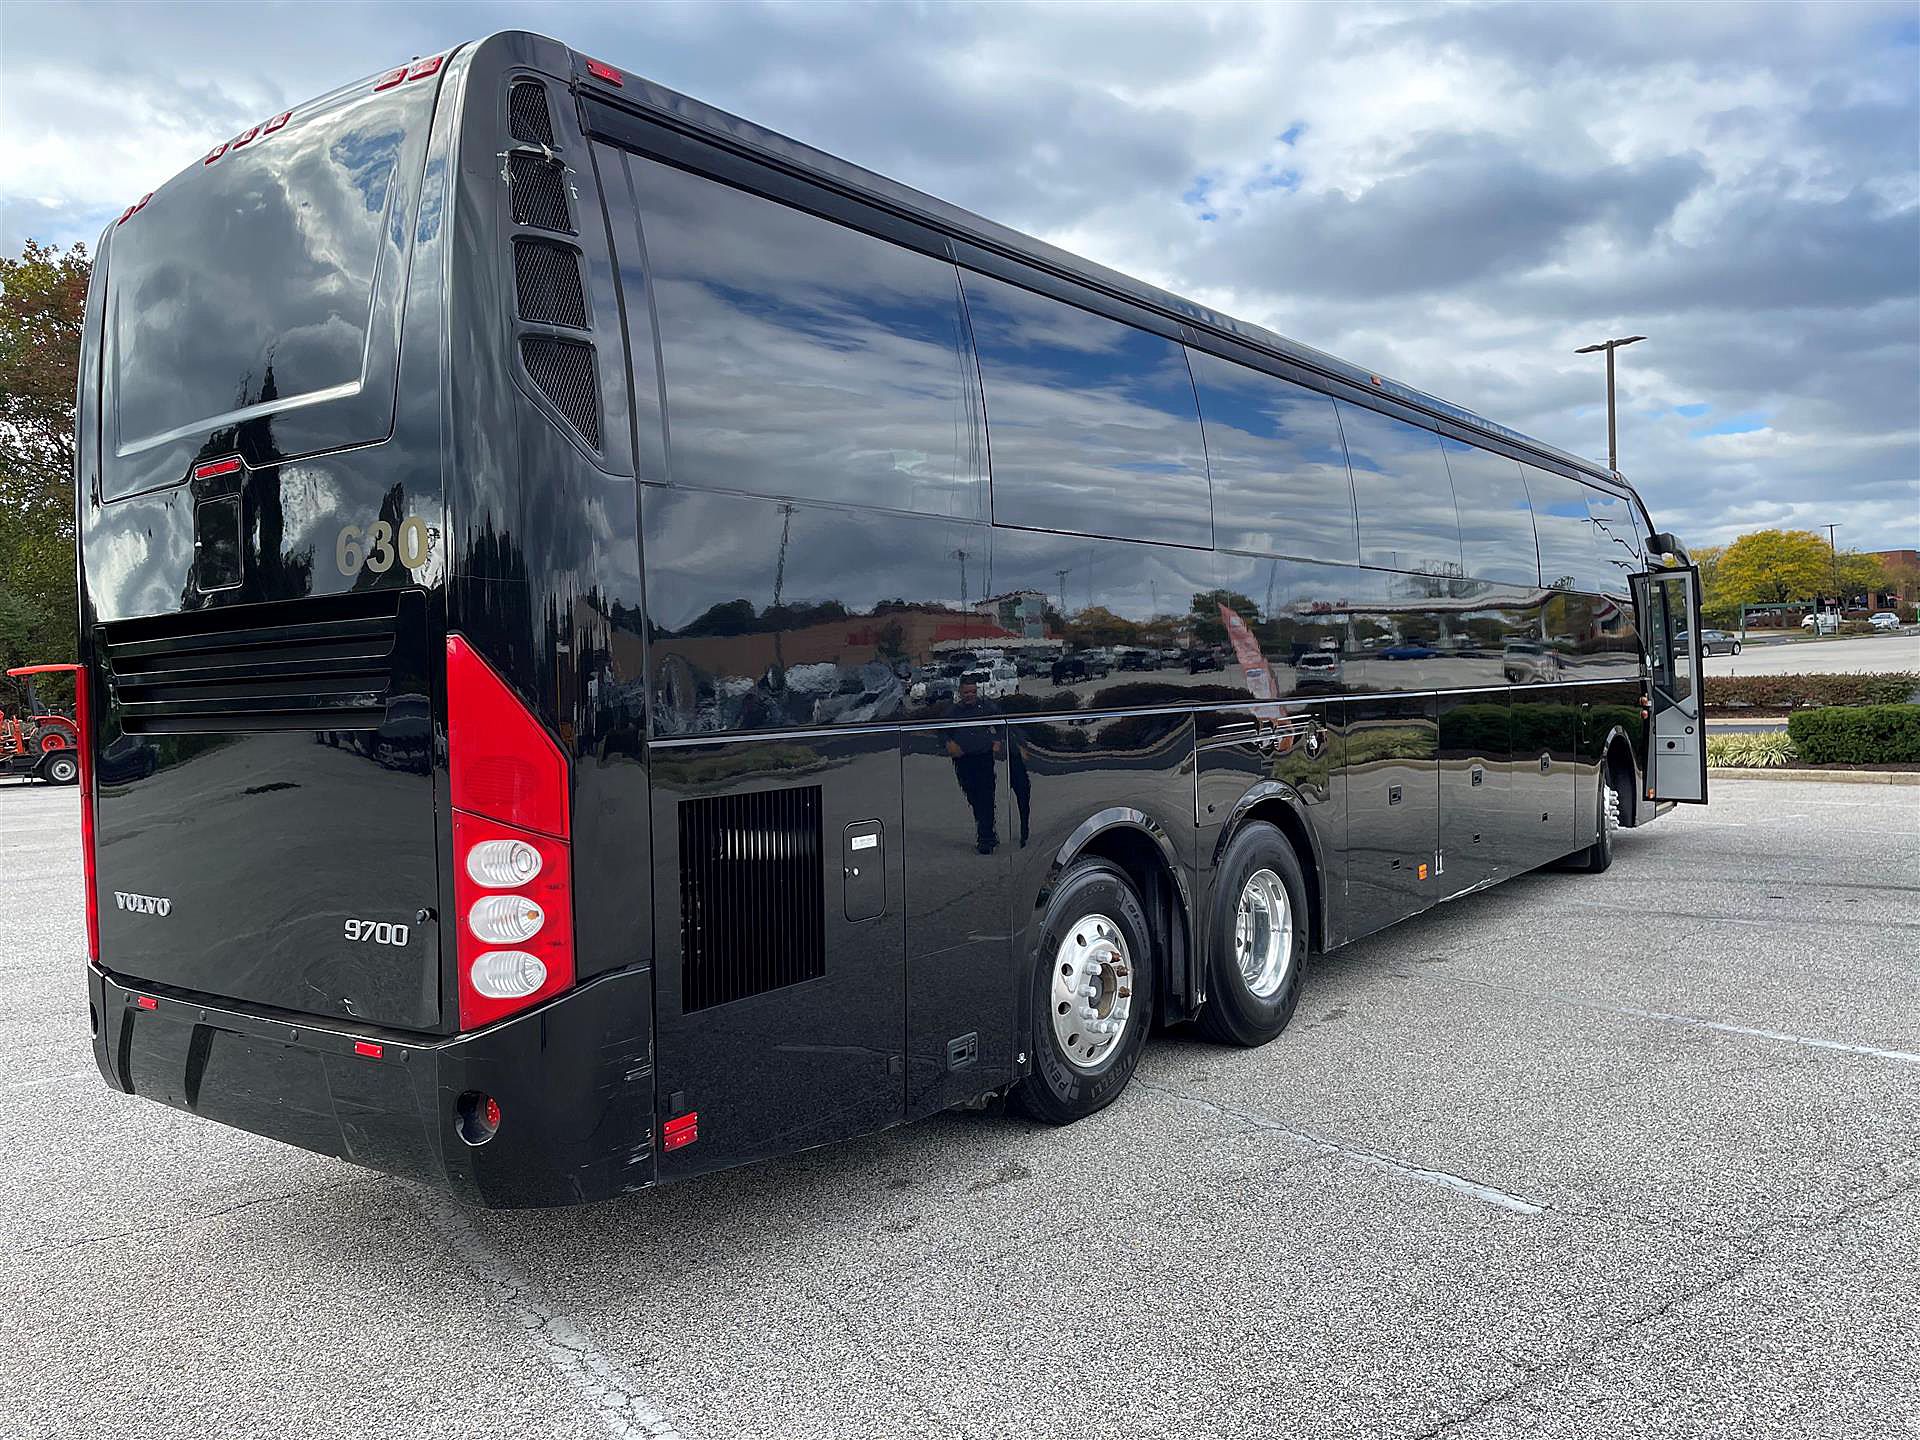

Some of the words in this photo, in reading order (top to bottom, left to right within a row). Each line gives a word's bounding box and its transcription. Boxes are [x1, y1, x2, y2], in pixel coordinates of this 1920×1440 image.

[335, 517, 428, 576] 630
[114, 891, 171, 916] VOLVO
[344, 919, 409, 946] 9700
